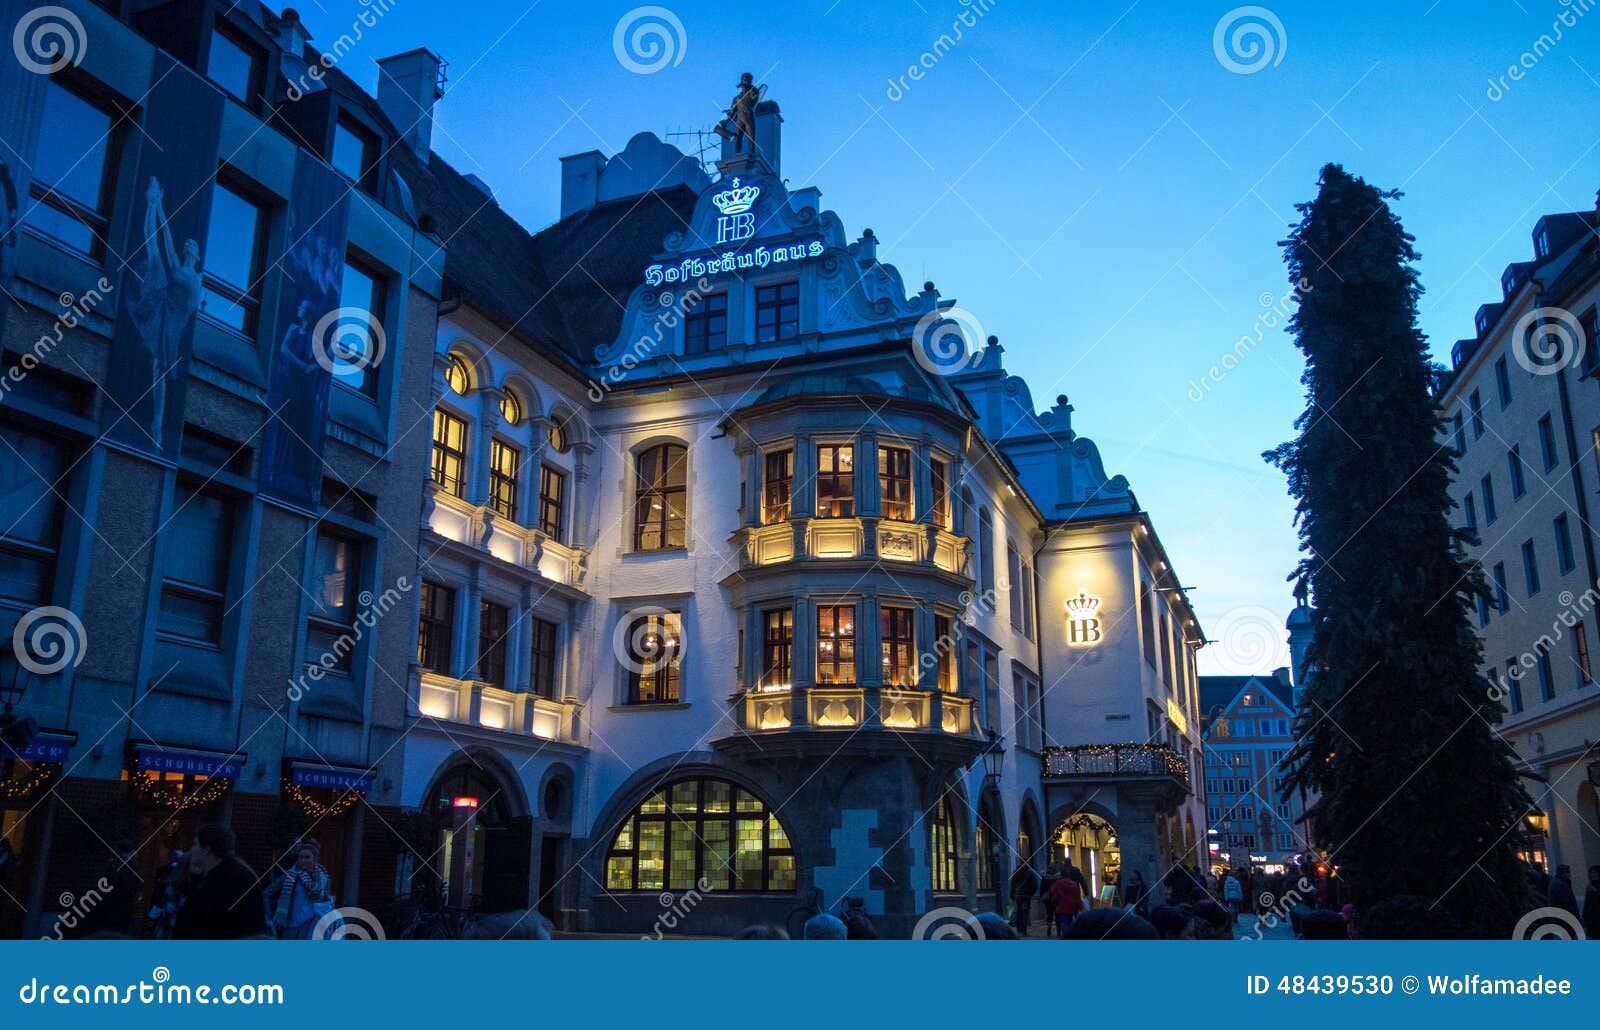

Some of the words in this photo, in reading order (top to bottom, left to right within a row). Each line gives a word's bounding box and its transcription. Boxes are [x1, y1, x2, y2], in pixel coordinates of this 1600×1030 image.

[716, 213, 755, 244] HB
[645, 241, 824, 286] Hofbräuhaus
[1070, 618, 1100, 642] HB
